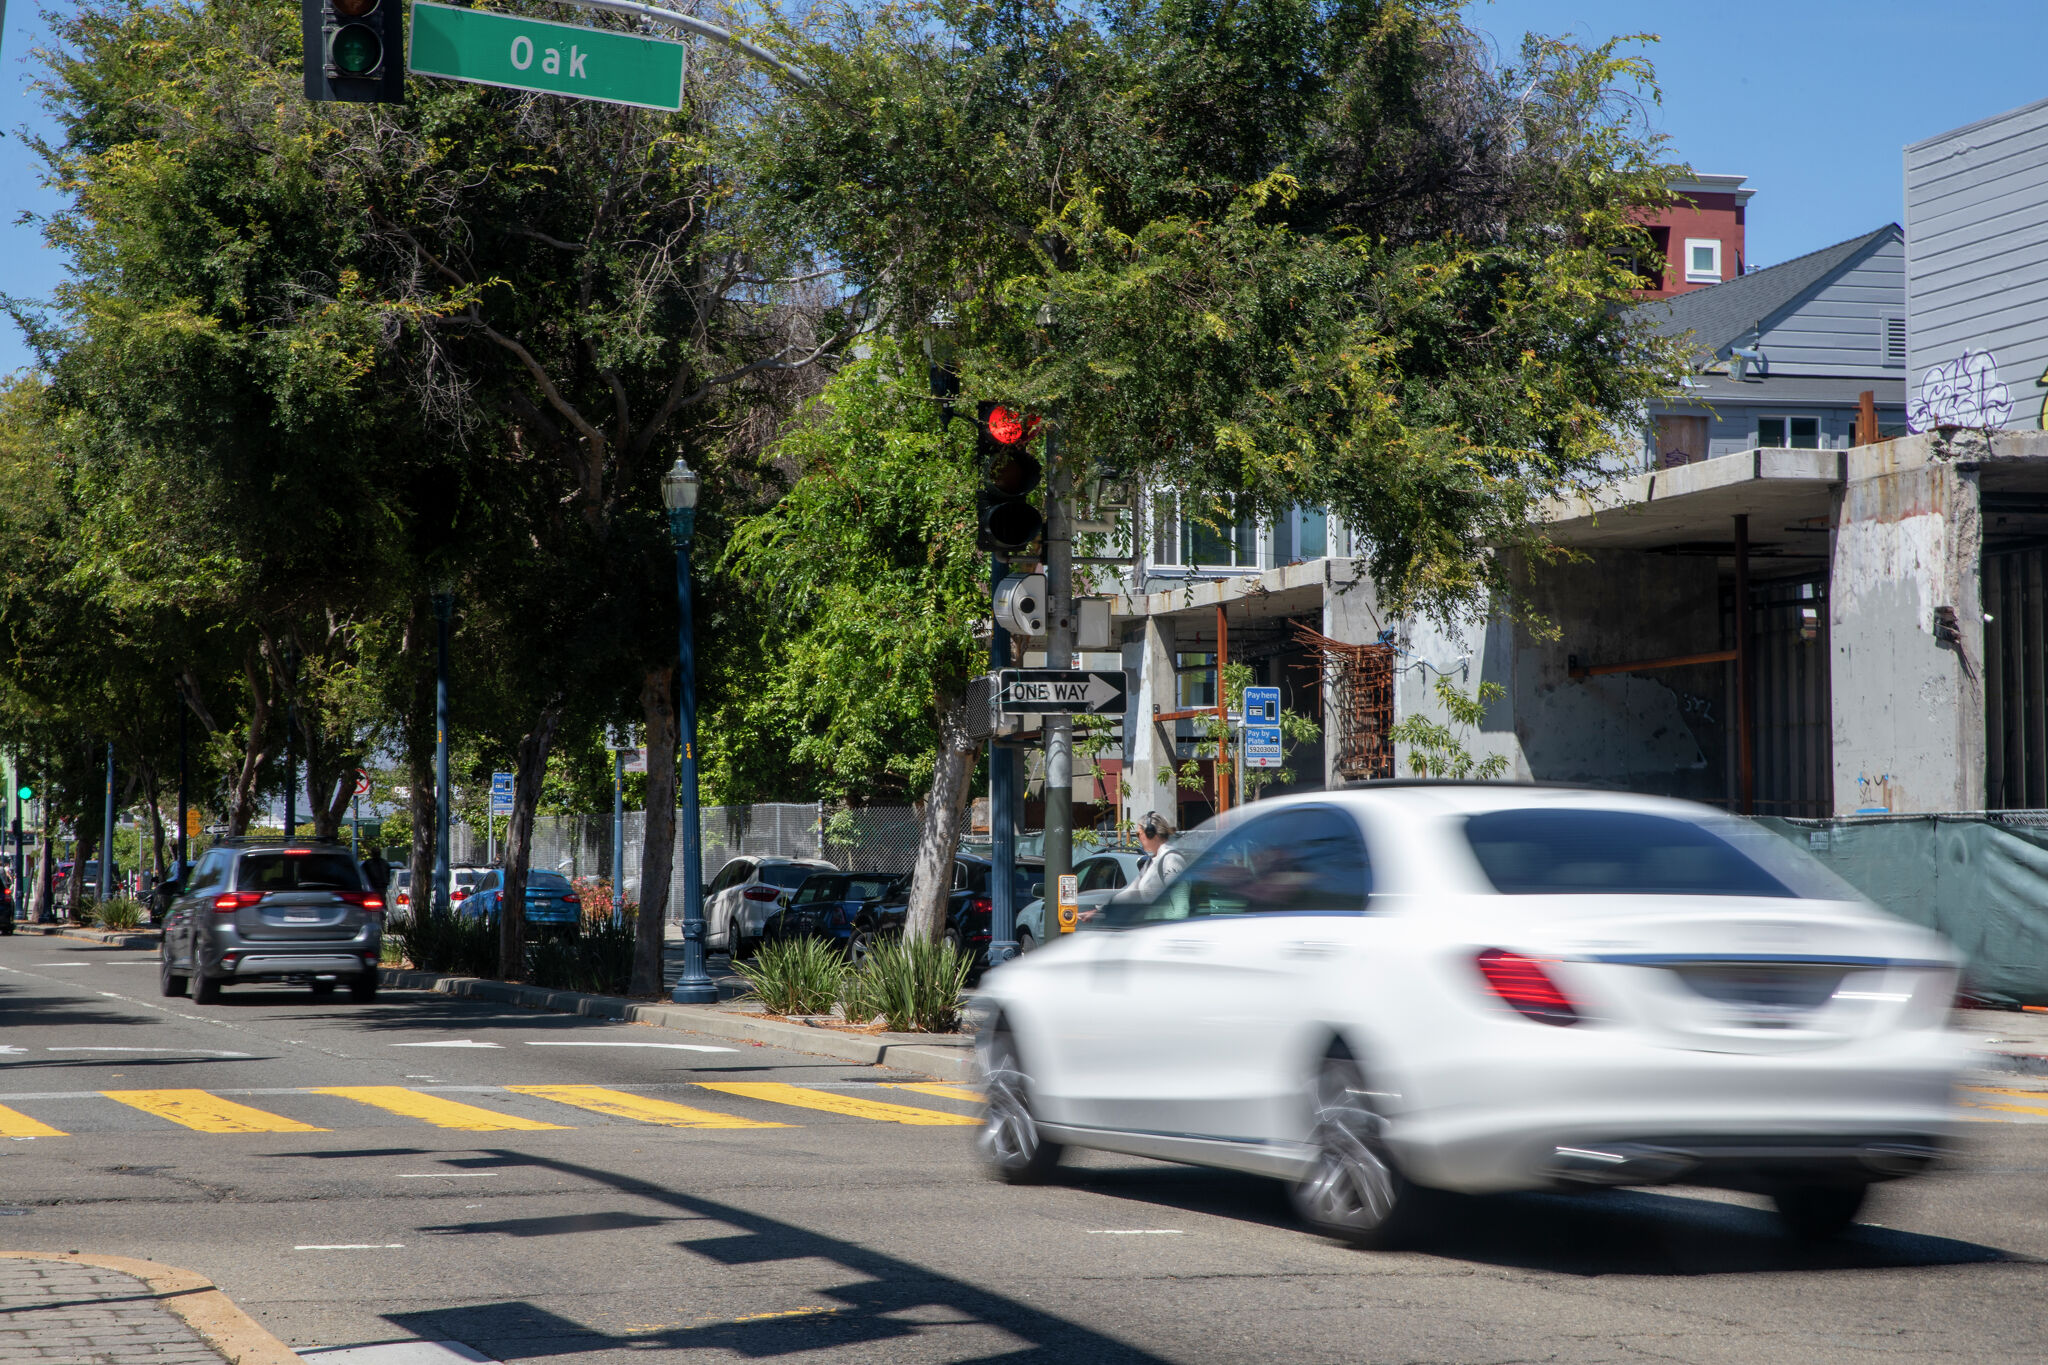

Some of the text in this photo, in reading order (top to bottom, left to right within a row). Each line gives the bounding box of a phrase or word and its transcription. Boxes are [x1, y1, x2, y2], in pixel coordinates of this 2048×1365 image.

[510, 35, 588, 79] Oak
[1014, 684, 1089, 700] ONE WAY
[1247, 691, 1277, 700] Pay here
[1247, 730, 1260, 738] Pay
